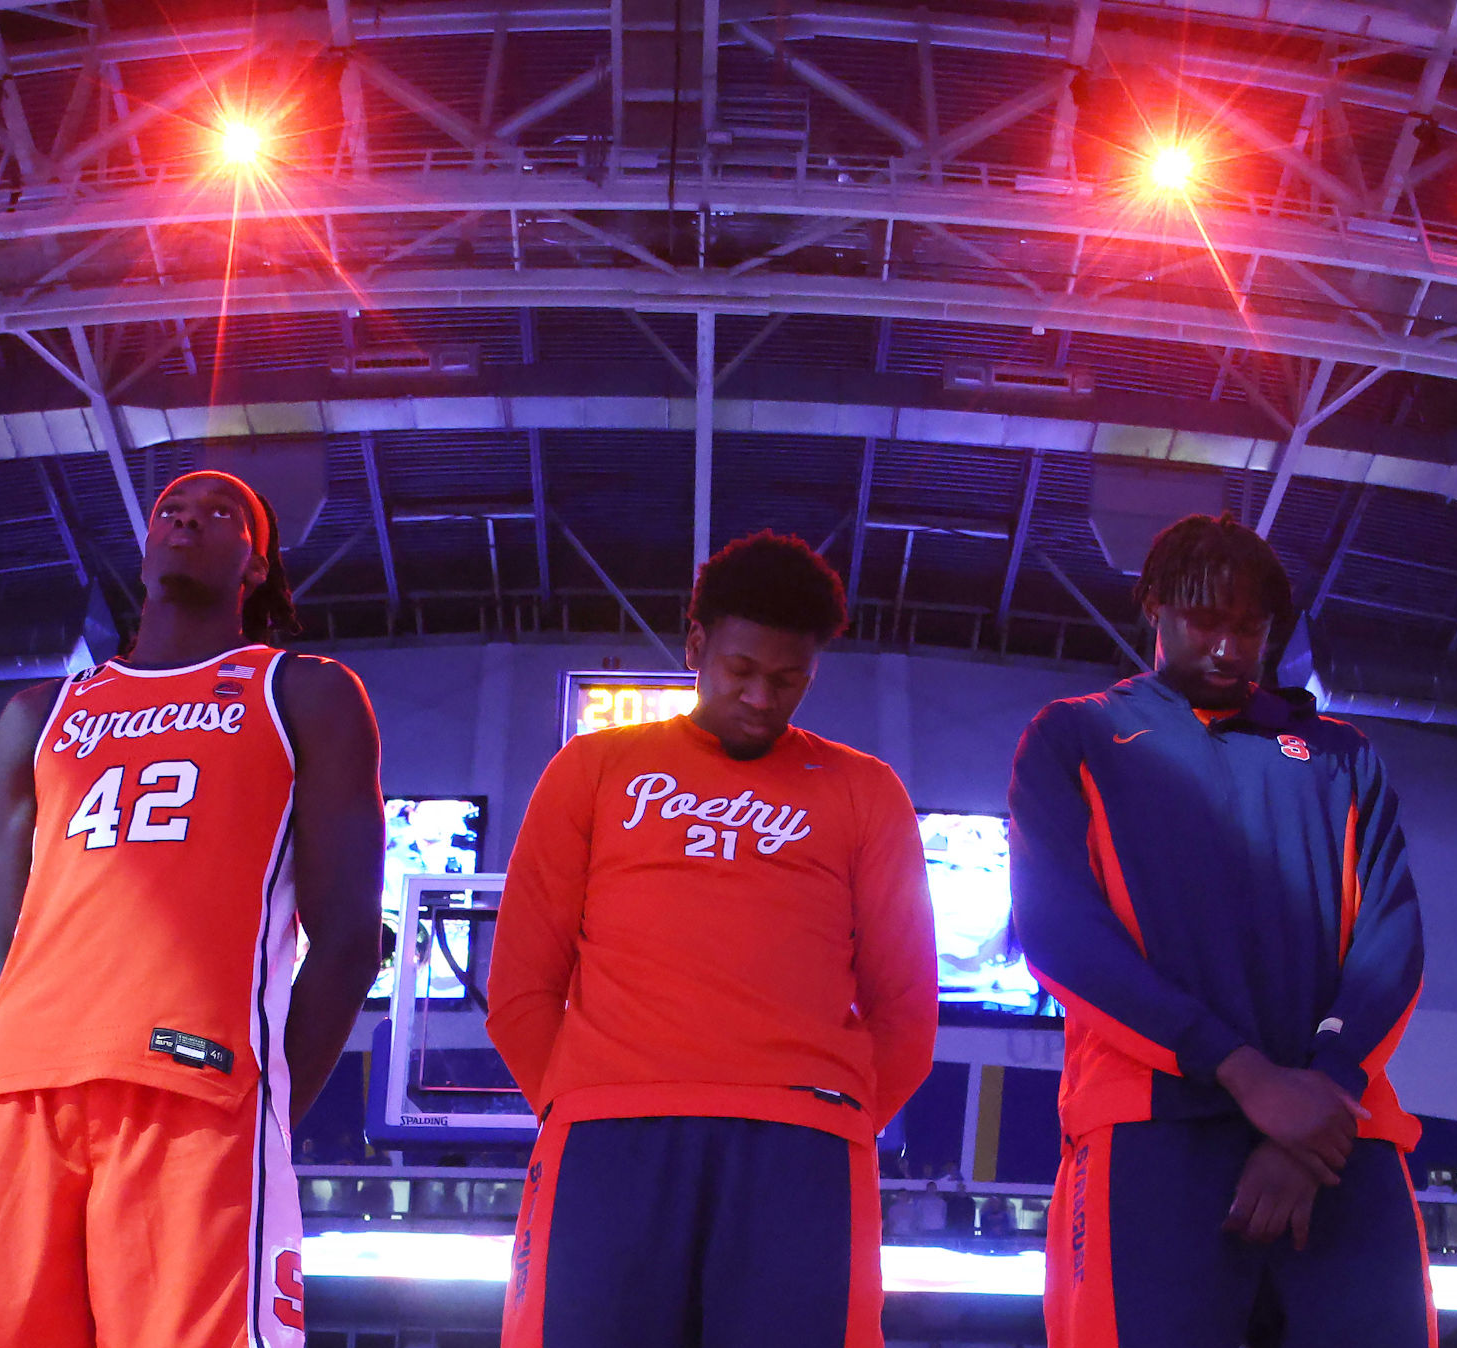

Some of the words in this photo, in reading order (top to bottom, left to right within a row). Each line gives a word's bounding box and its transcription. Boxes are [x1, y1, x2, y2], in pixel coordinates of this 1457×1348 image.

[53, 702, 247, 759] Syracuse
[66, 759, 200, 850] 42
[622, 772, 812, 855] Poetry
[684, 824, 738, 861] 21
[400, 1115, 448, 1126] SPALDING
